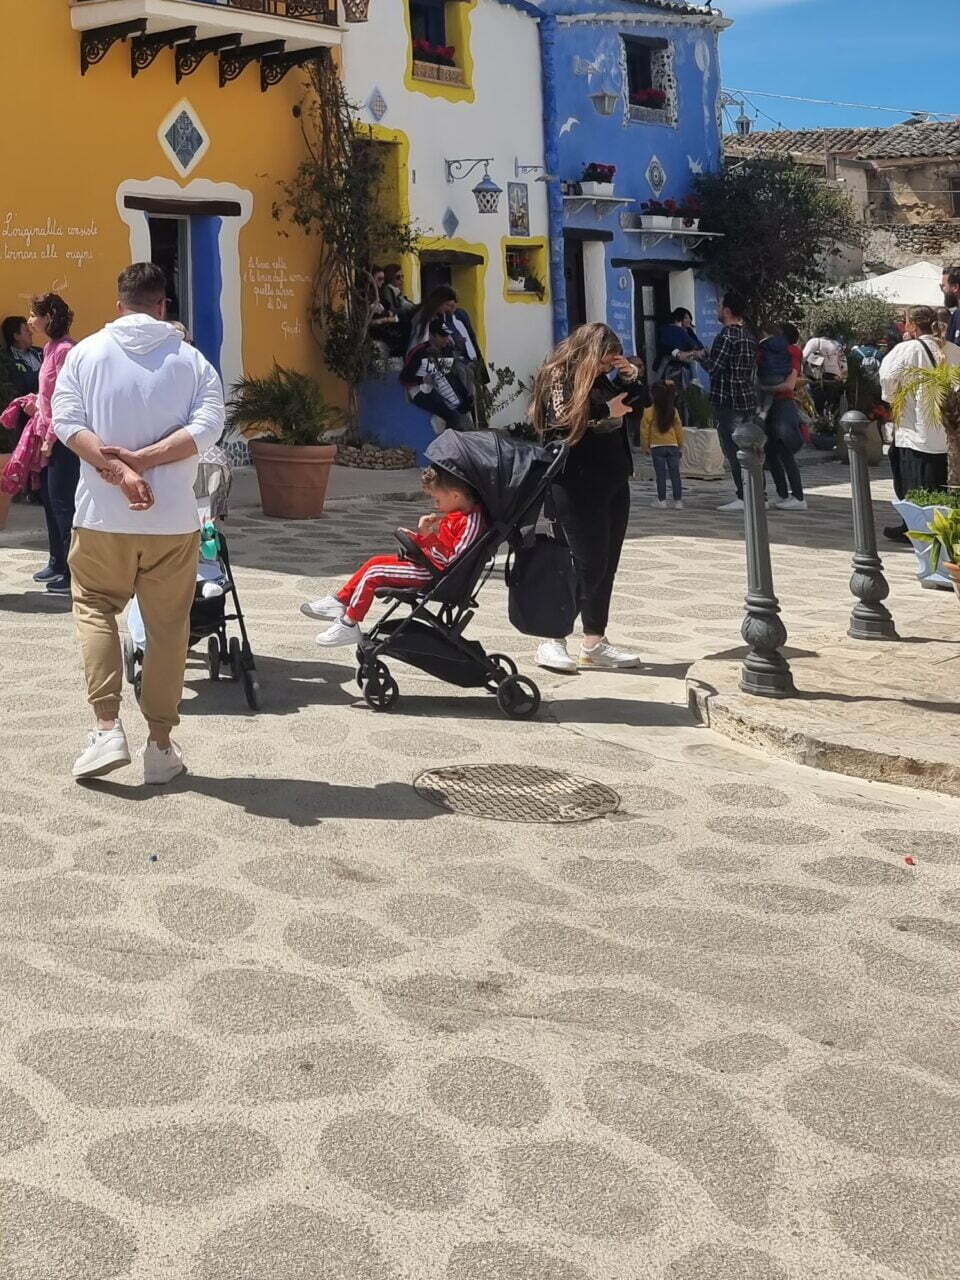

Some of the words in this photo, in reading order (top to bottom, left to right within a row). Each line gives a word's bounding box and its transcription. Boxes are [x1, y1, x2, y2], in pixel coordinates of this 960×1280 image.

[67, 218, 99, 237] consiste
[4, 242, 38, 261] tornare
[40, 243, 59, 260] alle
[65, 250, 93, 268] origini
